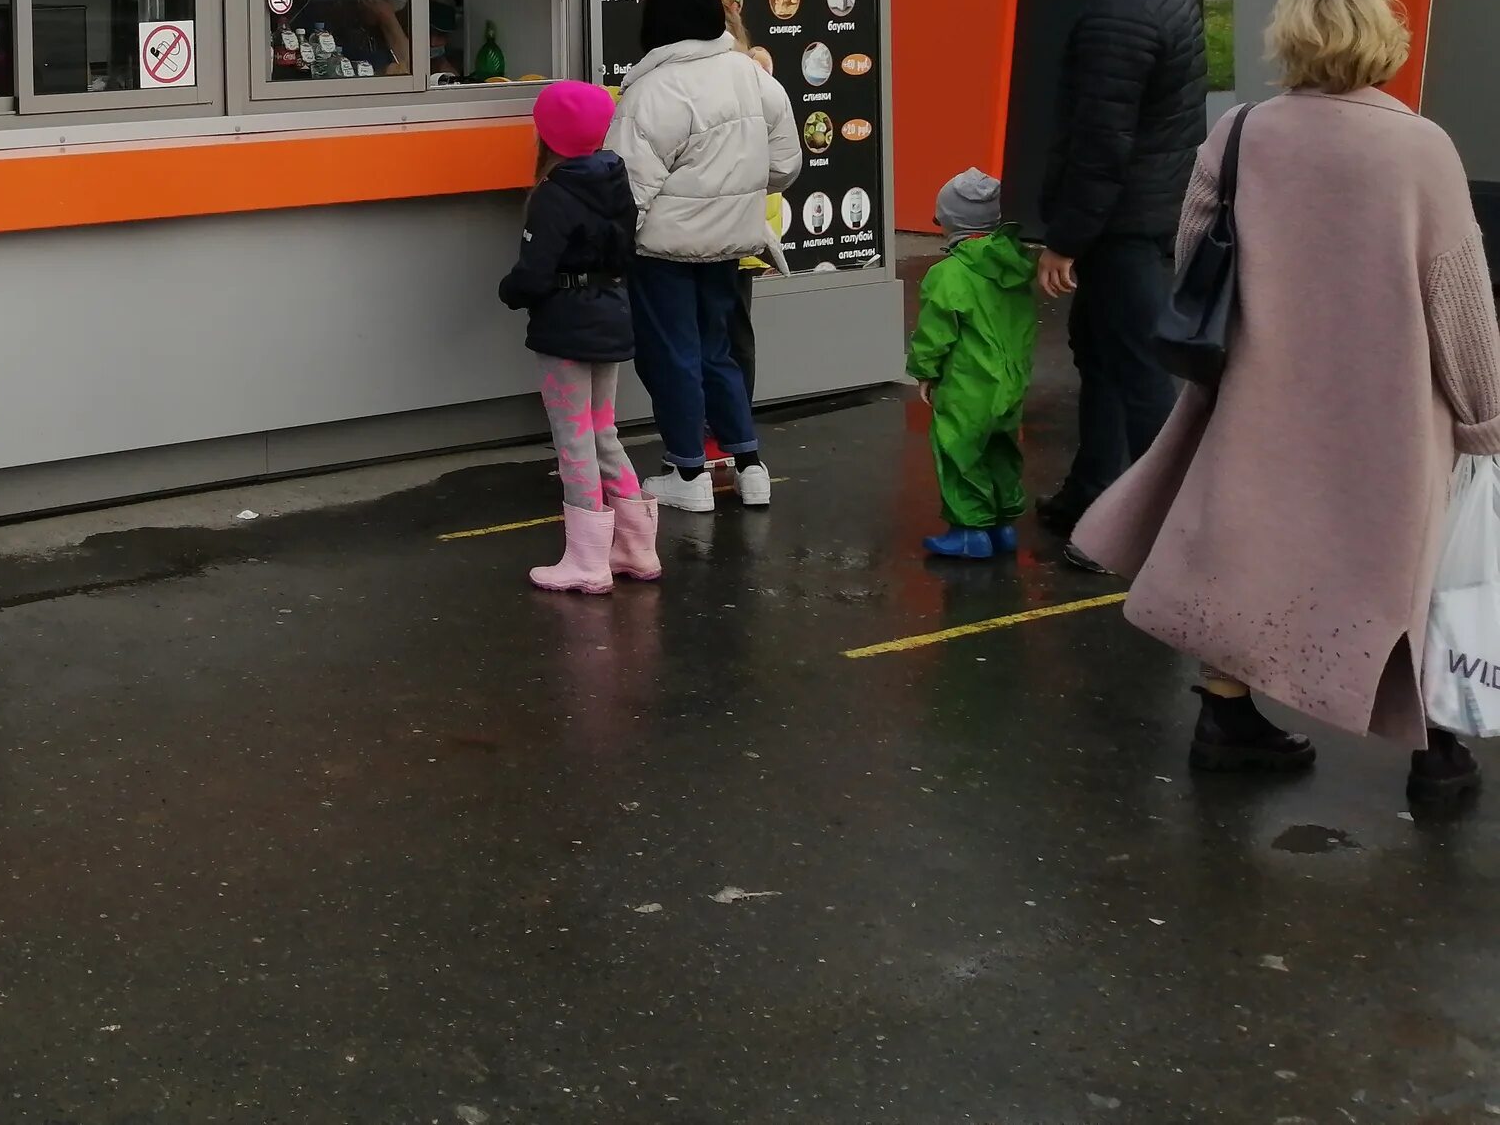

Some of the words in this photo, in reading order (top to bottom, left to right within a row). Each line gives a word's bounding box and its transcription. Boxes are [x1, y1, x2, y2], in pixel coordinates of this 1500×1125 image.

[770, 25, 801, 35] сникерс
[828, 21, 854, 32] баунти
[803, 237, 834, 247] малина
[841, 230, 872, 244] голубой
[839, 248, 876, 259] апельсин
